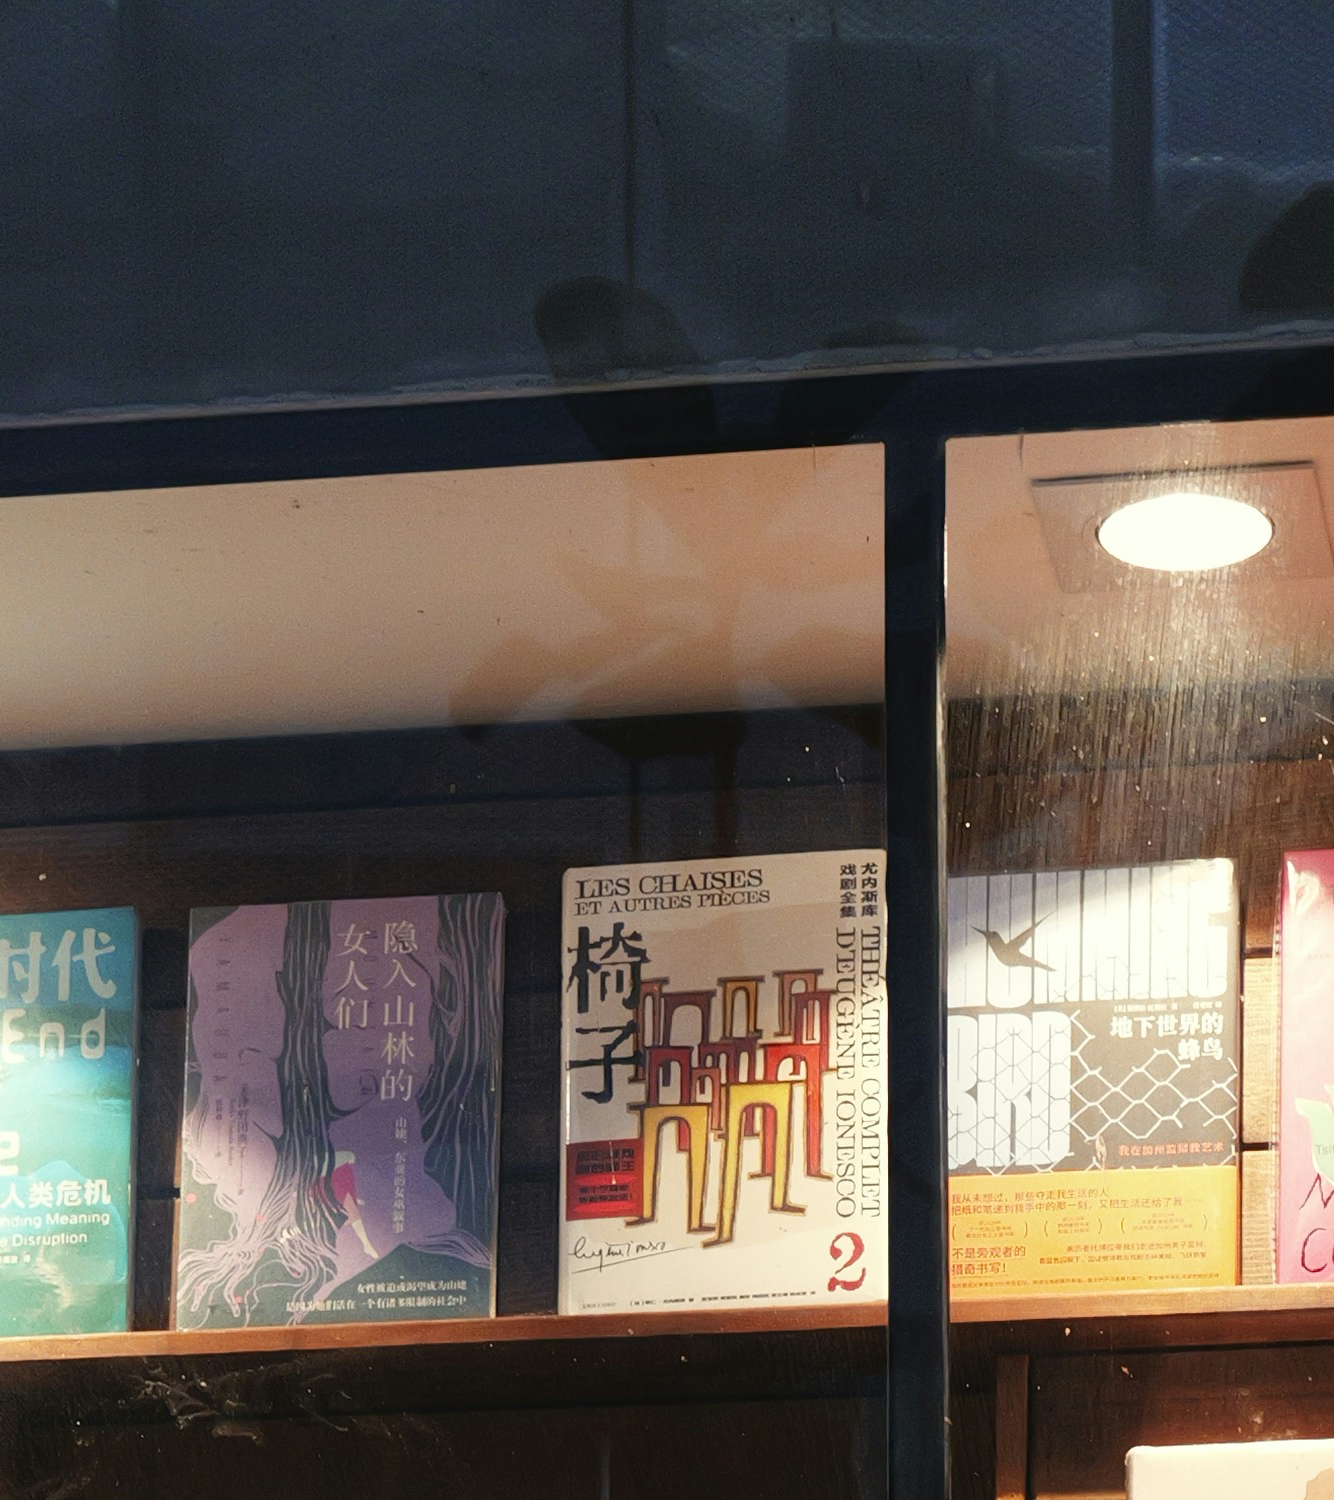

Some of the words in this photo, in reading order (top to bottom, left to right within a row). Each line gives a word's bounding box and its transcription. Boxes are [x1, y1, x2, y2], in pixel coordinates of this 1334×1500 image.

[573, 901, 603, 916] ET
[607, 893, 693, 914] AUTRES
[696, 889, 771, 909] PIÈCES
[575, 877, 631, 900] LES
[638, 868, 764, 895] CHAISES
[839, 863, 858, 919] 戏剧全集
[860, 862, 879, 918] 尤内斯库
[334, 923, 371, 1030] 女人们
[835, 926, 858, 1080] D'EUGÈNE
[860, 926, 884, 1068] THÉÂTRE
[1, 1007, 107, 1064] End
[380, 920, 418, 1101] 隐入山林的
[565, 921, 652, 1104] 椅子
[1110, 1012, 1224, 1039] 地下世界的
[1177, 1038, 1224, 1062] 蜂鸟
[835, 1089, 857, 1219] IONESCO
[860, 1078, 883, 1218] COMPLET
[1118, 1142, 1225, 1158] 我在加州监狱教艺术
[12, 1232, 88, 1249] Disruption
[45, 1211, 111, 1226] Meaning
[827, 1231, 867, 1293] 2
[951, 1245, 1027, 1260] 不是旁观者的
